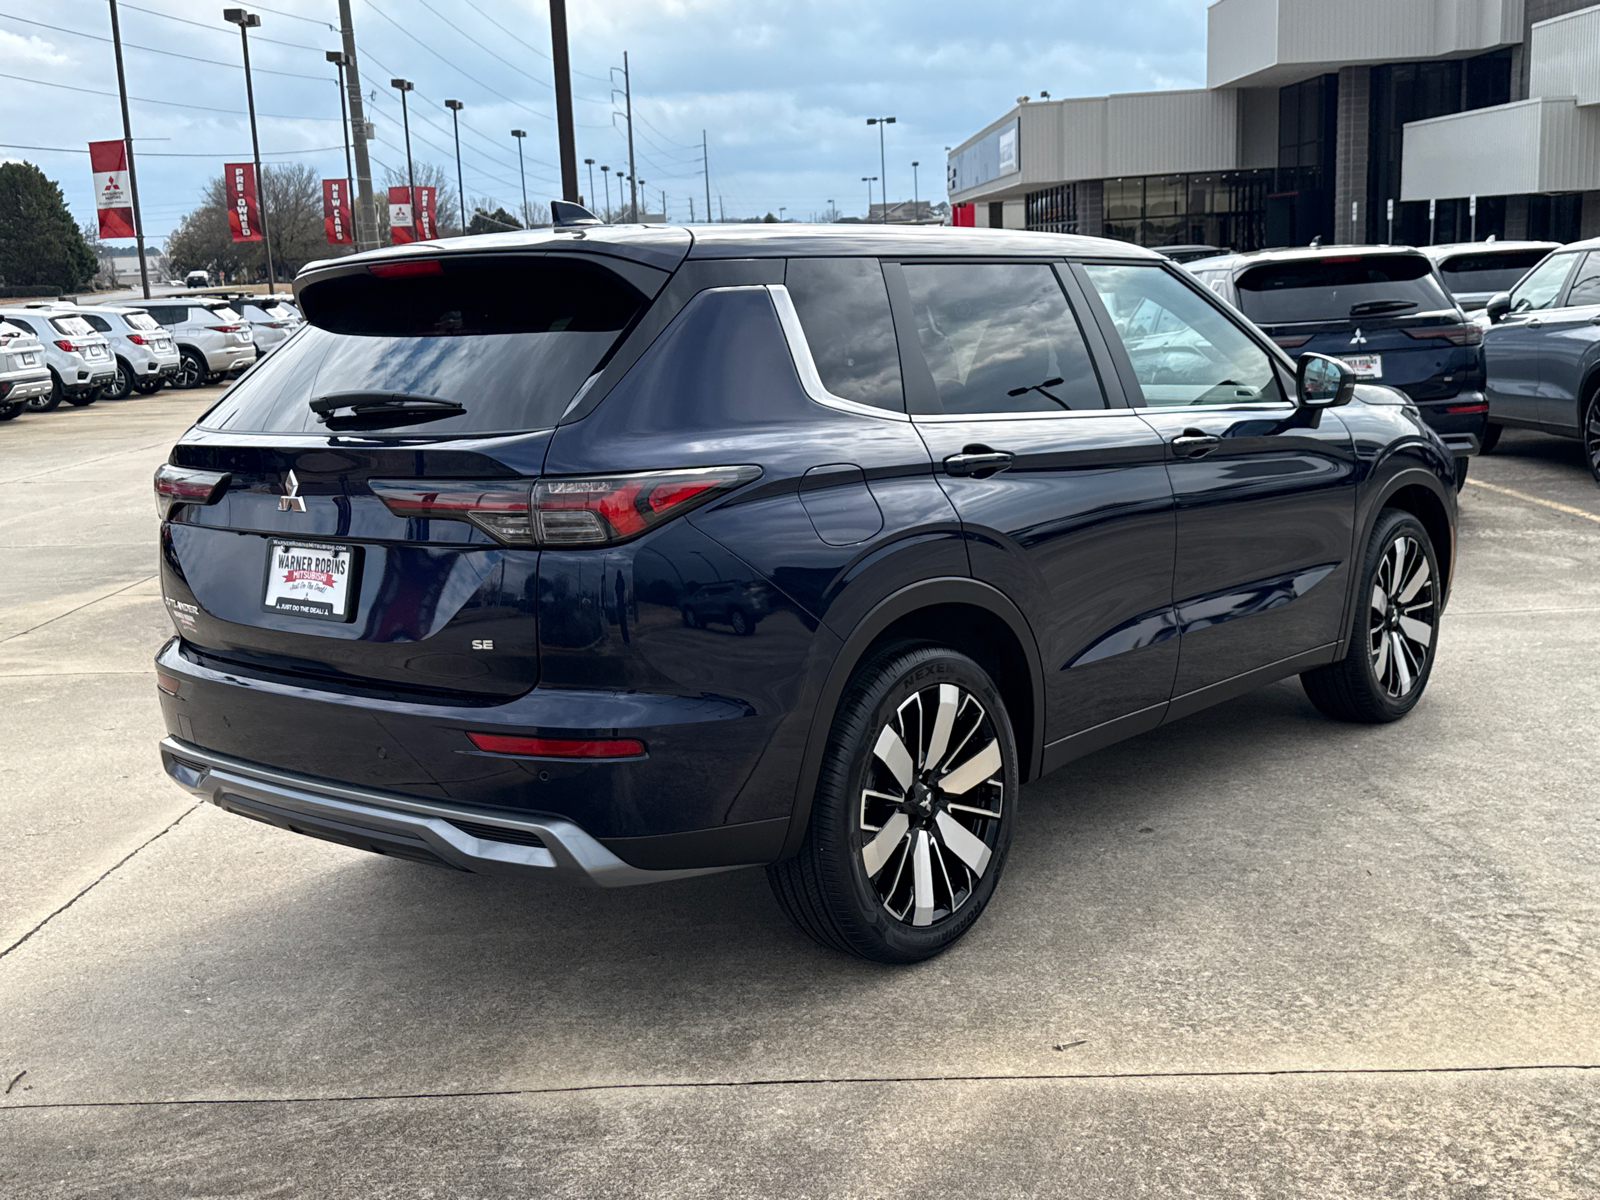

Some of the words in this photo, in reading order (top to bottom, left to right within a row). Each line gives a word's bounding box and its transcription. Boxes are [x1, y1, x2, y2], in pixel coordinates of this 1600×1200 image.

[235, 168, 251, 236] PRE-OWNED
[331, 183, 341, 207] NEW
[333, 209, 343, 240] CARS
[278, 553, 313, 571] WARNER
[315, 557, 346, 575] ROBINS
[293, 570, 328, 582] MITSUBISHI
[280, 603, 293, 611] JUST
[300, 605, 309, 613] THE
[471, 639, 494, 650] SE
[903, 663, 957, 690] NEXEN
